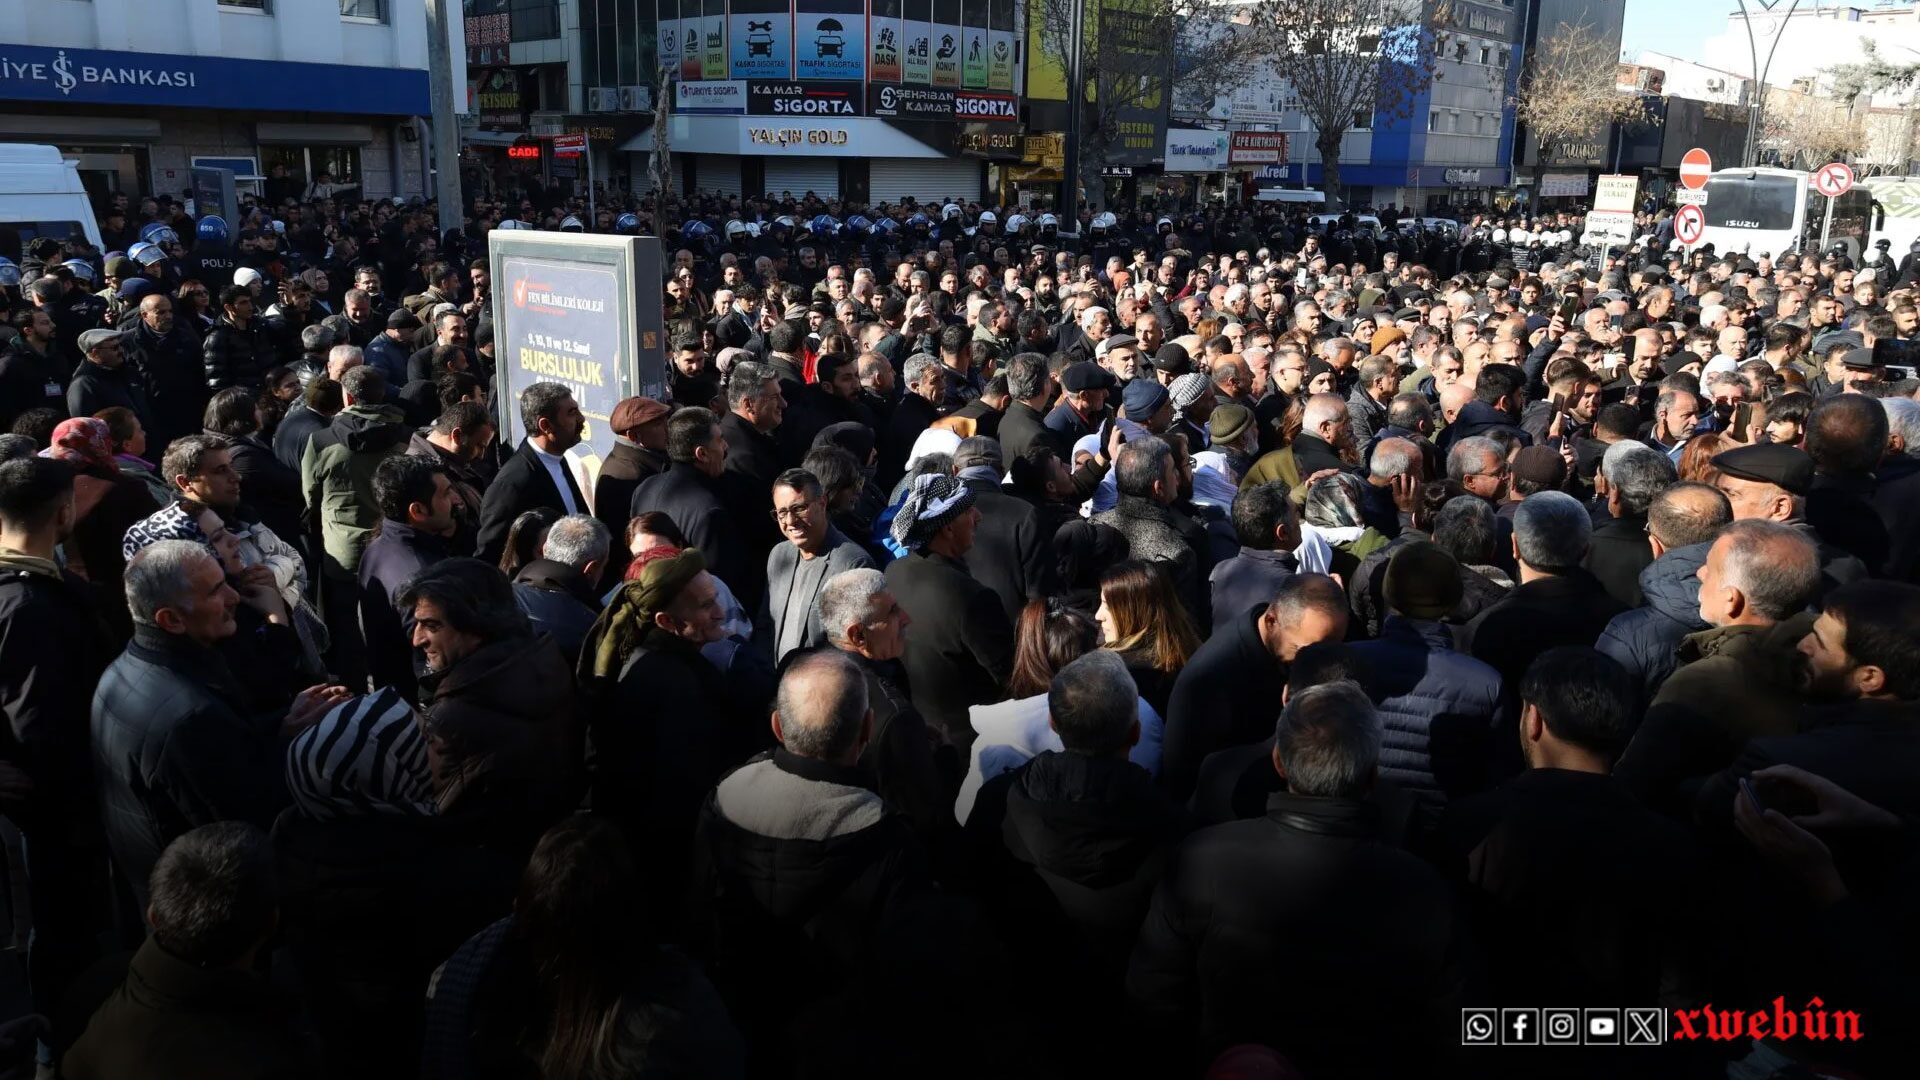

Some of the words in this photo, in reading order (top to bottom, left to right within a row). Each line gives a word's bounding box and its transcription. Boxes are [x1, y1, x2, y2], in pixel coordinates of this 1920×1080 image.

[875, 53, 897, 66] DASK
[0, 57, 48, 80] İYE
[82, 66, 196, 88] BANKASI
[753, 85, 803, 95] KAMAR
[906, 101, 950, 113] KAMAR
[749, 129, 802, 146] YALÇIN
[808, 129, 847, 144] GOLD
[1725, 220, 1760, 229] ISUZU
[528, 292, 540, 303] FEN
[520, 347, 603, 387] BURSLULUK
